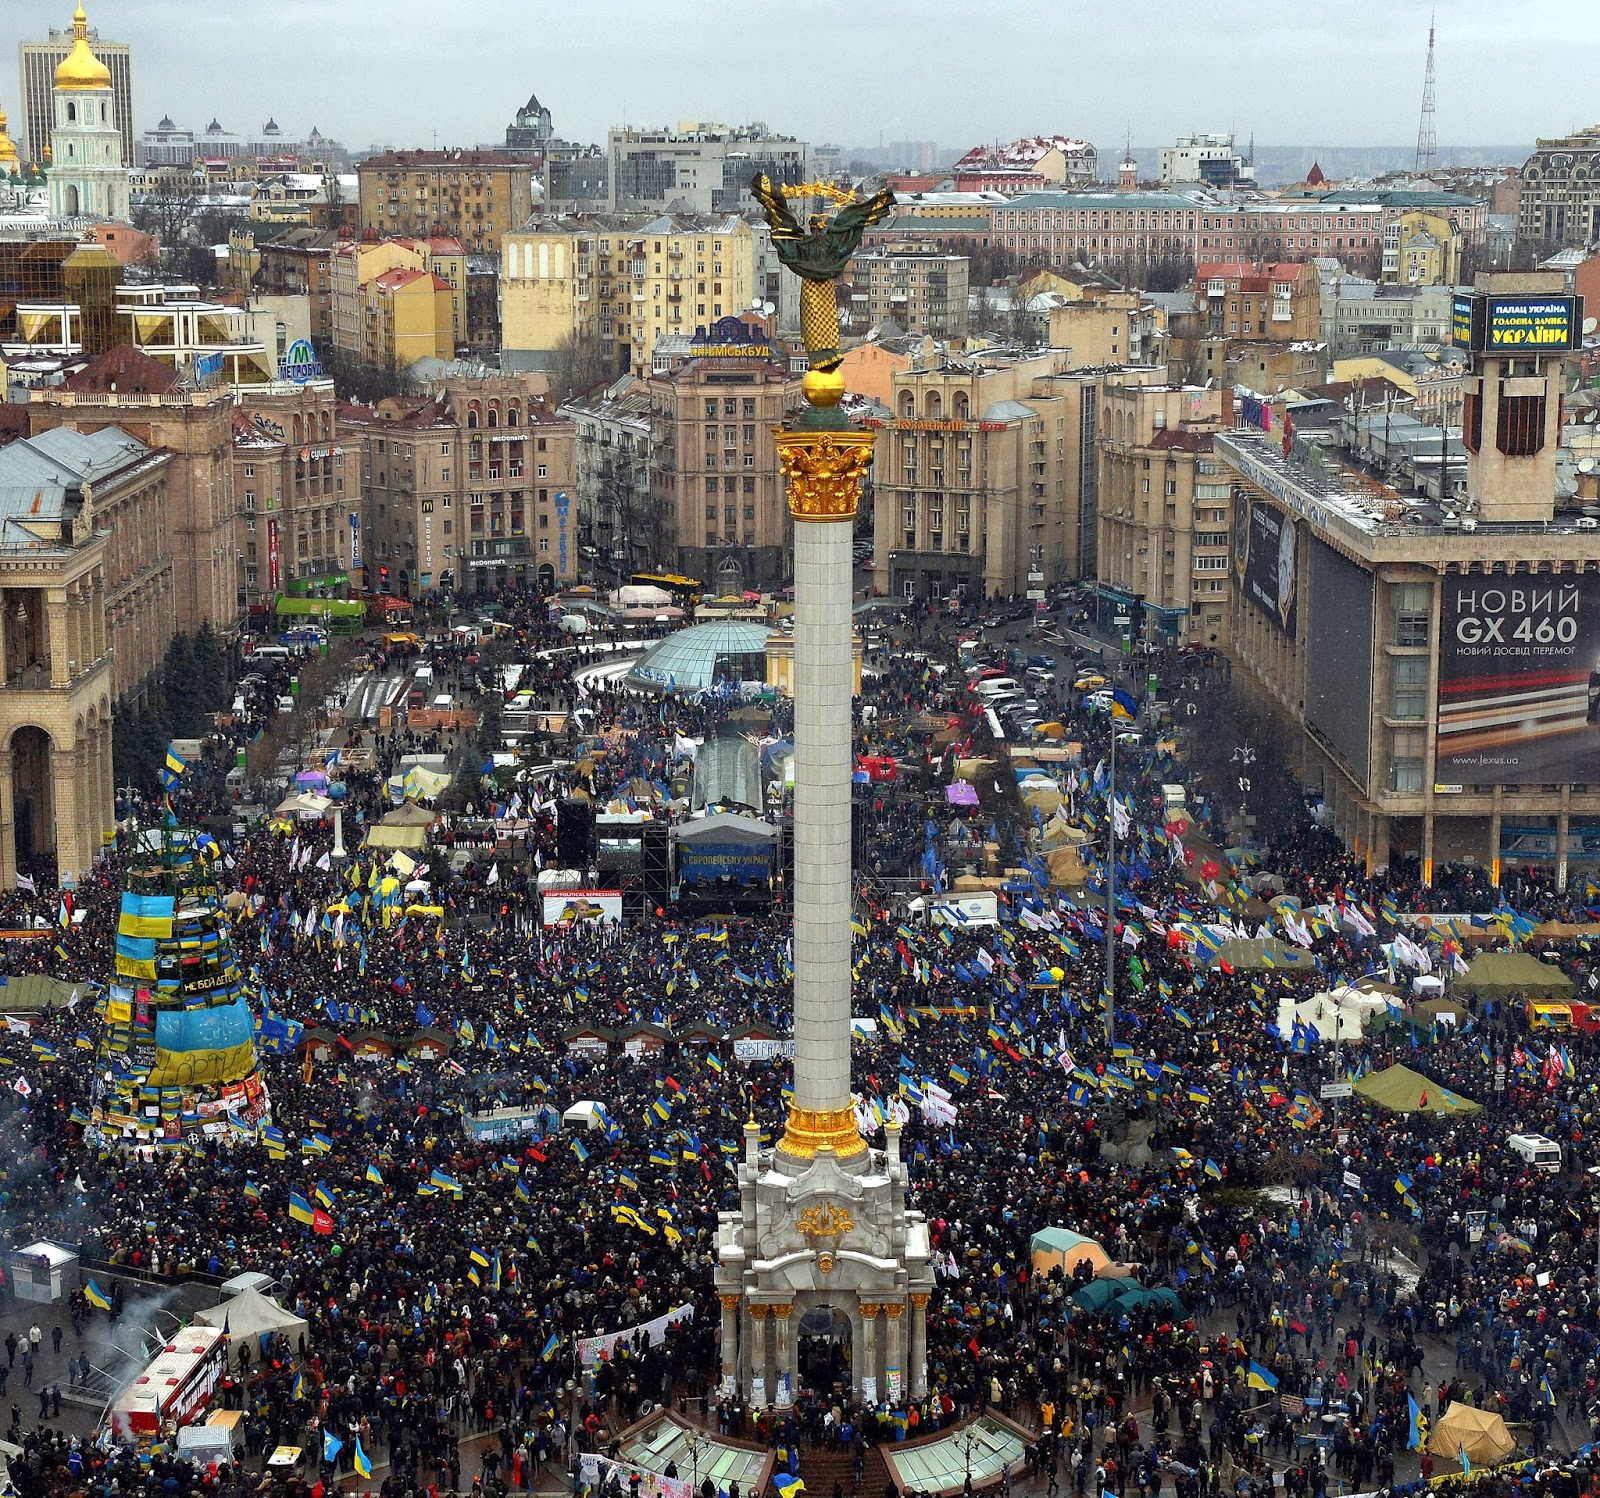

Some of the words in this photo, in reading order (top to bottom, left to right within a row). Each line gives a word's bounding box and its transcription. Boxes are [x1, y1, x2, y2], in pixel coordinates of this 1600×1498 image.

[1496, 306, 1527, 315] ПАЛАЦ
[1529, 304, 1566, 314] УКРАЇНА
[1493, 317, 1533, 326] ГОЛОВНА
[1492, 326, 1568, 343] УКРАЇНИ
[690, 346, 769, 357] КИЇВМІСЬКБУД
[279, 363, 322, 379] МЕТРОБУД
[898, 421, 962, 432] КОЗАЦЬКИЙ
[492, 434, 528, 442] McDonald's
[469, 558, 506, 566] McDonald's
[1457, 583, 1579, 613] НОВИЙ
[1456, 617, 1505, 643] GX
[1512, 616, 1578, 643] 460
[1456, 645, 1491, 655] НОВИЙ
[1493, 647, 1530, 656] ДОСВІД
[1533, 646, 1576, 655] ПЕРЕМОГ
[1452, 755, 1519, 765] www.lexus.ua
[688, 854, 741, 865] ЄВРОПЕЙСЬКУ
[184, 981, 197, 992] НЕ
[197, 976, 216, 989] БЕЙ
